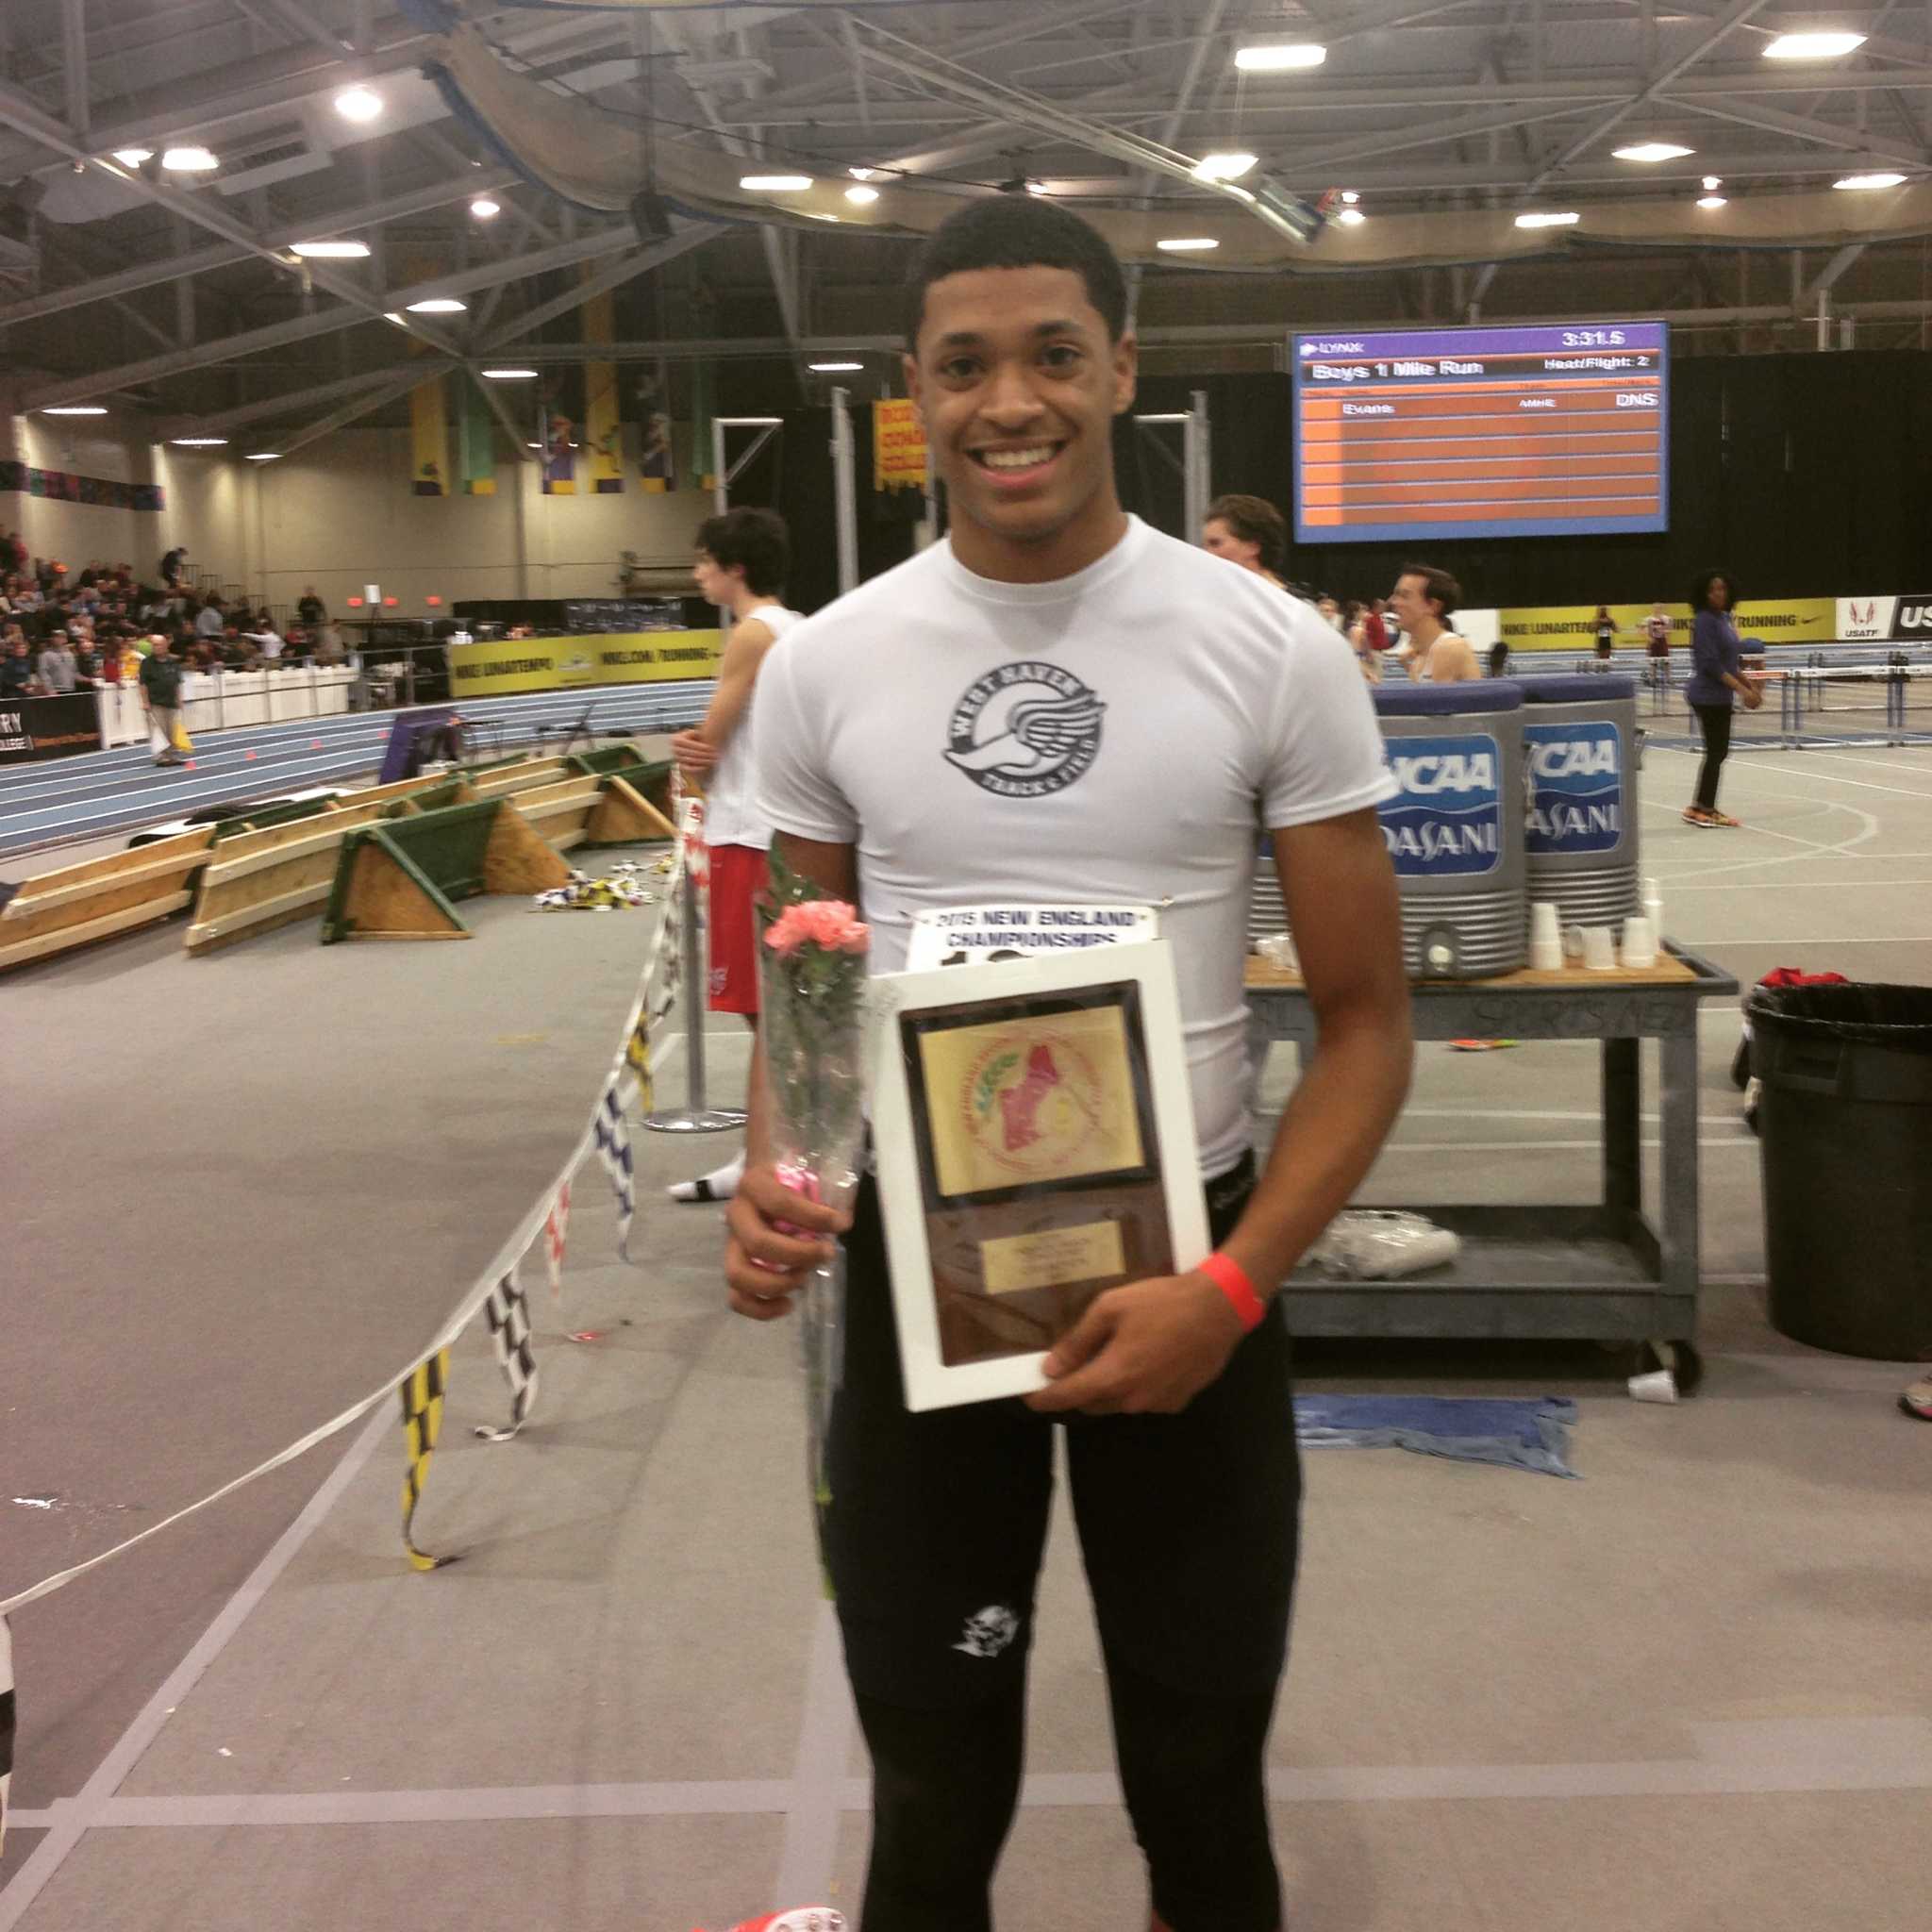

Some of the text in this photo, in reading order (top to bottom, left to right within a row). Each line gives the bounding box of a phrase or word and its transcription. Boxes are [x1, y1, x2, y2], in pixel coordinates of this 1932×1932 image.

[1312, 359, 1485, 382] Boys 1 Mile Run
[1637, 355, 1651, 367] 2
[1342, 403, 1395, 415] Evans
[1616, 392, 1658, 408] DNS
[1532, 740, 1617, 777] CAA
[1525, 803, 1621, 840] ASANI
[983, 910, 1031, 925] NEW
[1039, 911, 1134, 926] ENGLAND
[947, 932, 1117, 947] CHAMPIONSHIPS
